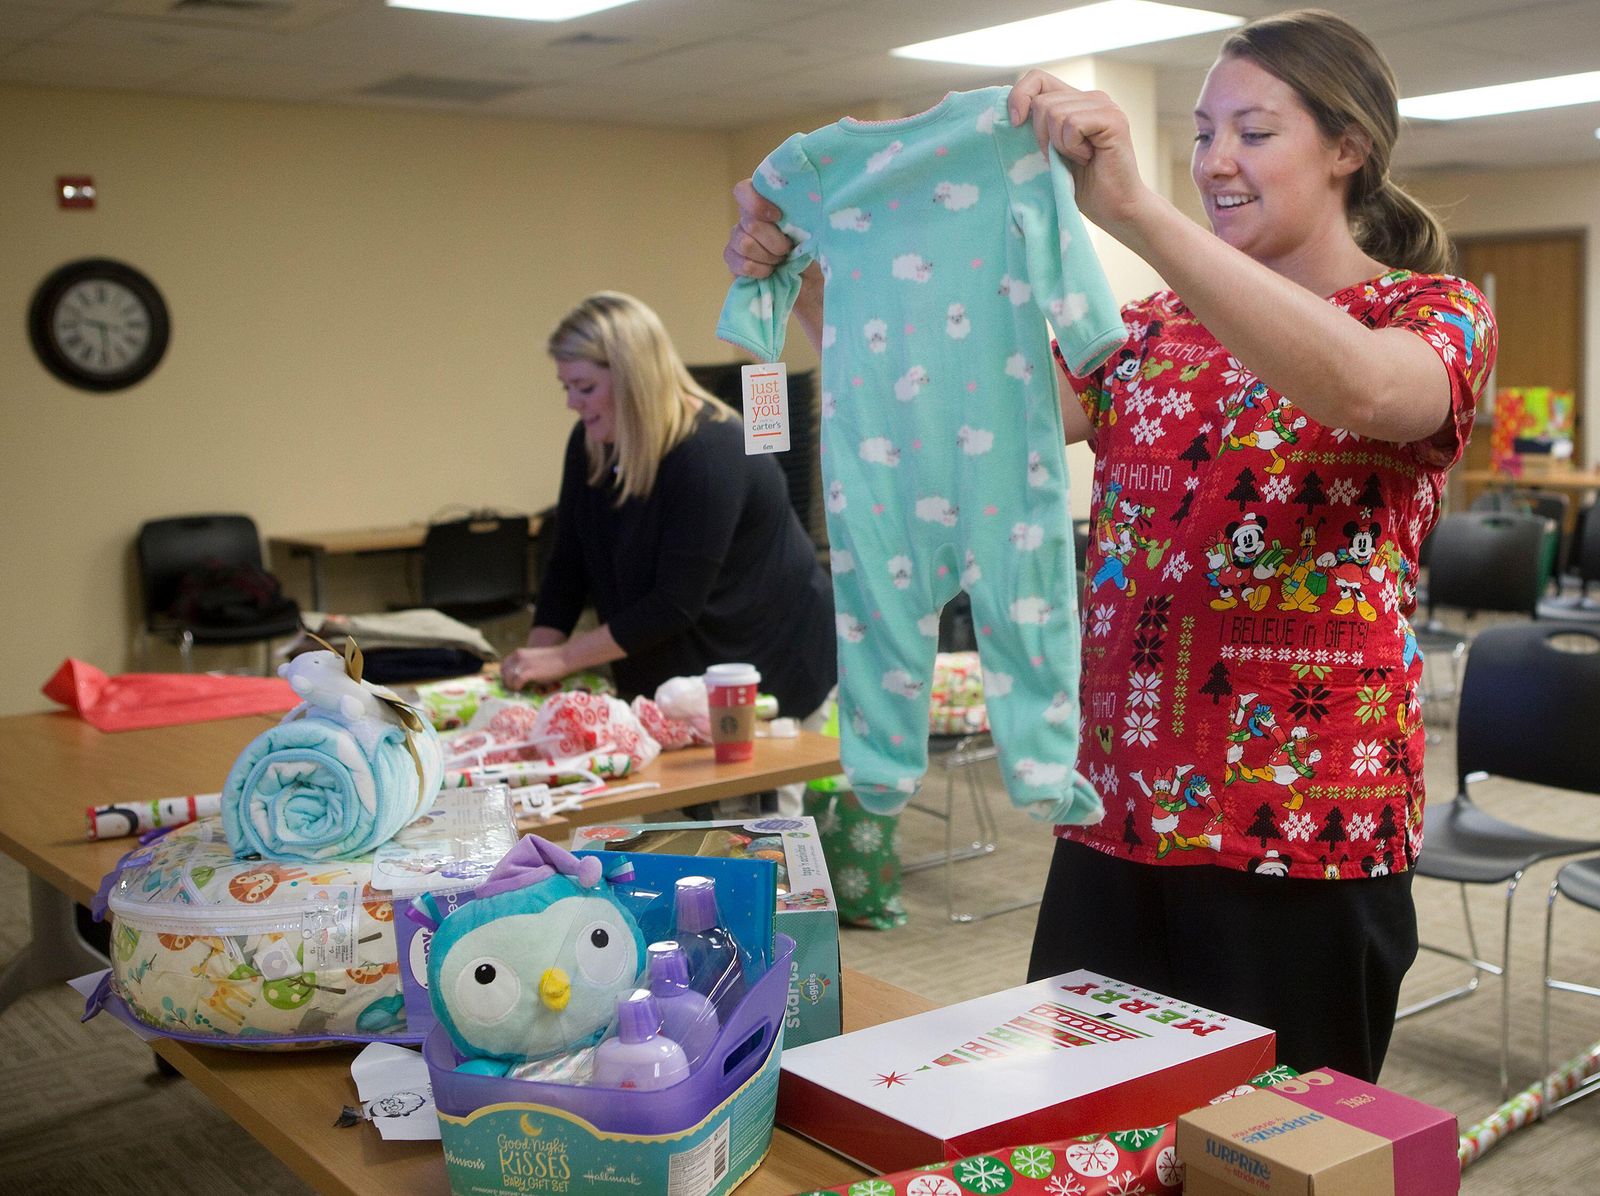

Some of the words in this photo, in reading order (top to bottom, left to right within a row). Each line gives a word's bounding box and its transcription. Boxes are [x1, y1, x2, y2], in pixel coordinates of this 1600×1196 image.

[751, 379, 779, 400] just
[755, 393, 780, 405] one
[752, 404, 780, 423] you
[752, 421, 781, 431] carter's
[1129, 464, 1148, 490] HO
[1151, 465, 1172, 491] HO
[1231, 616, 1296, 646] BELIEVE
[809, 973, 818, 1005] taggies
[1060, 982, 1226, 1037] MERRY
[497, 1134, 530, 1153] Good
[551, 1180, 570, 1193] SET
[583, 1169, 642, 1185] Hallmark
